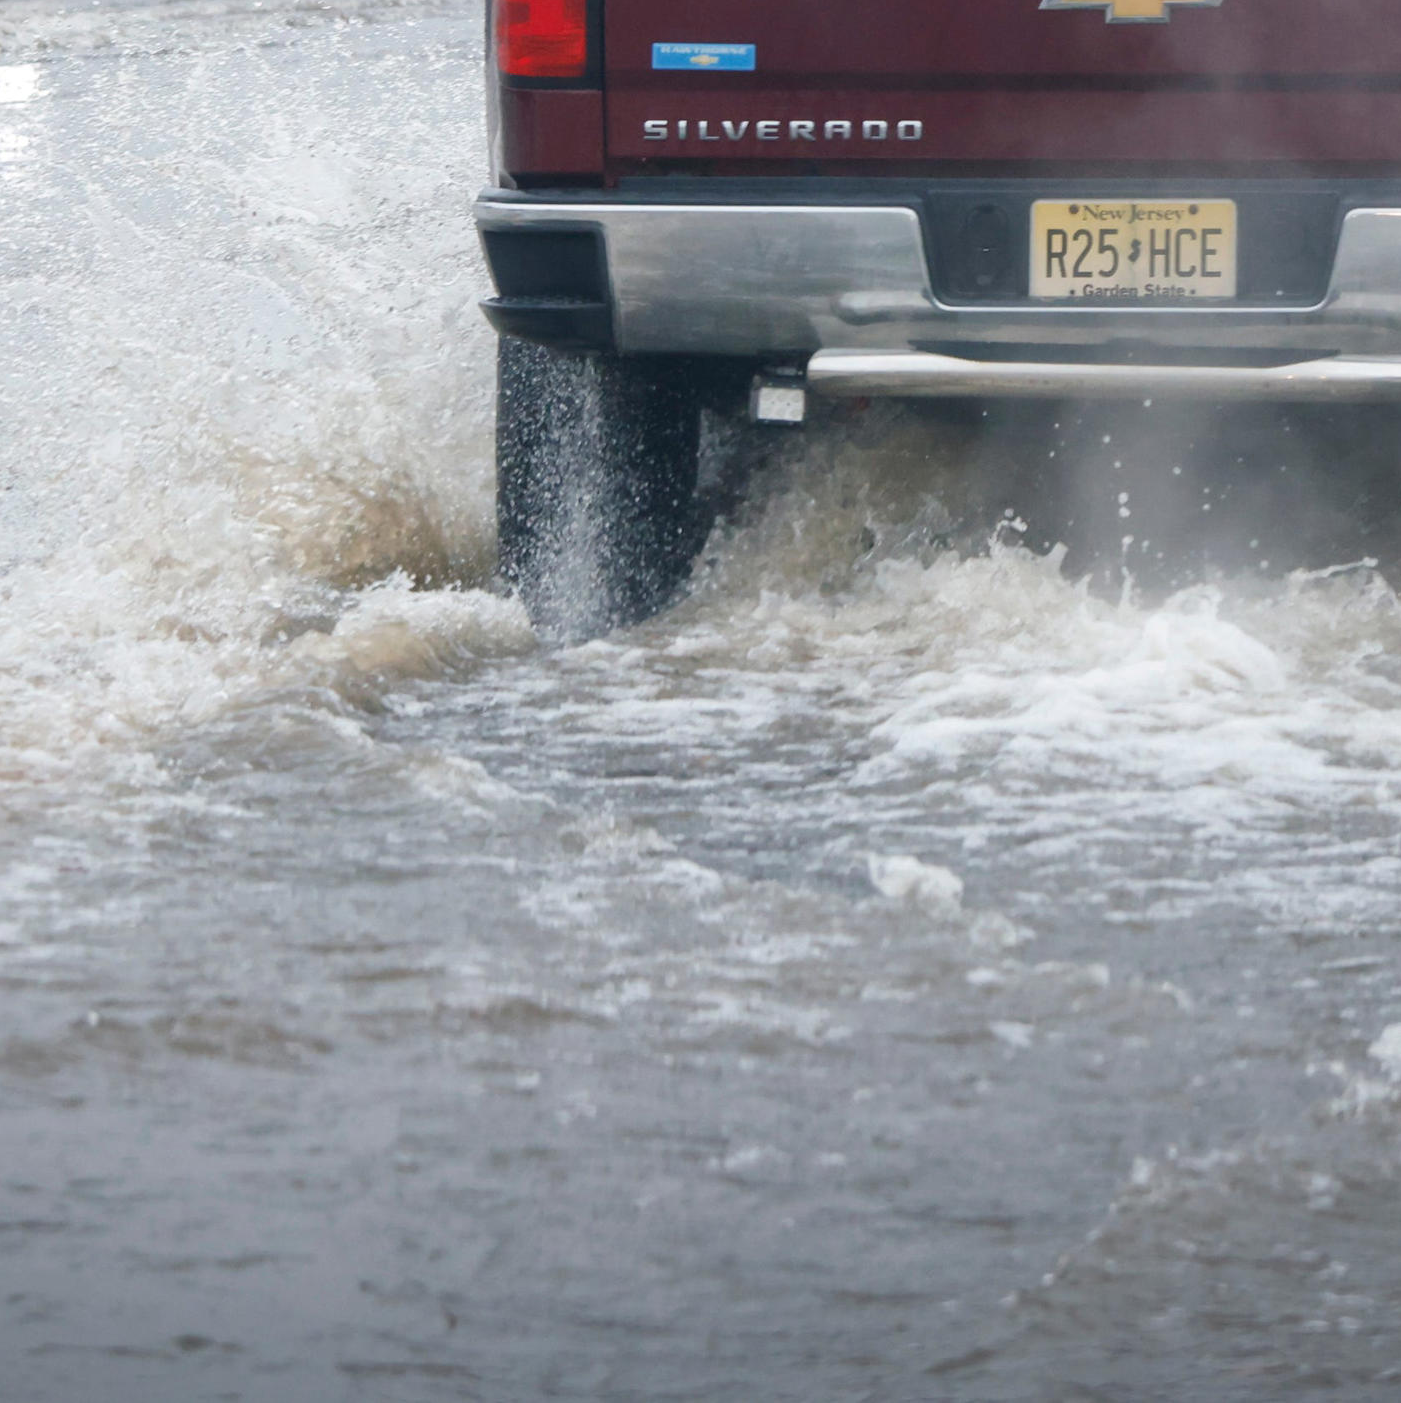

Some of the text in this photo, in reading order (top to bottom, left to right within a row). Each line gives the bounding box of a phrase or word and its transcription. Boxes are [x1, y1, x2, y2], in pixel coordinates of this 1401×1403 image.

[643, 119, 924, 141] SILVERADO
[1082, 204, 1186, 224] New Jersey
[1045, 228, 1223, 278] R25 HCE
[1082, 284, 1185, 298] Garden State
